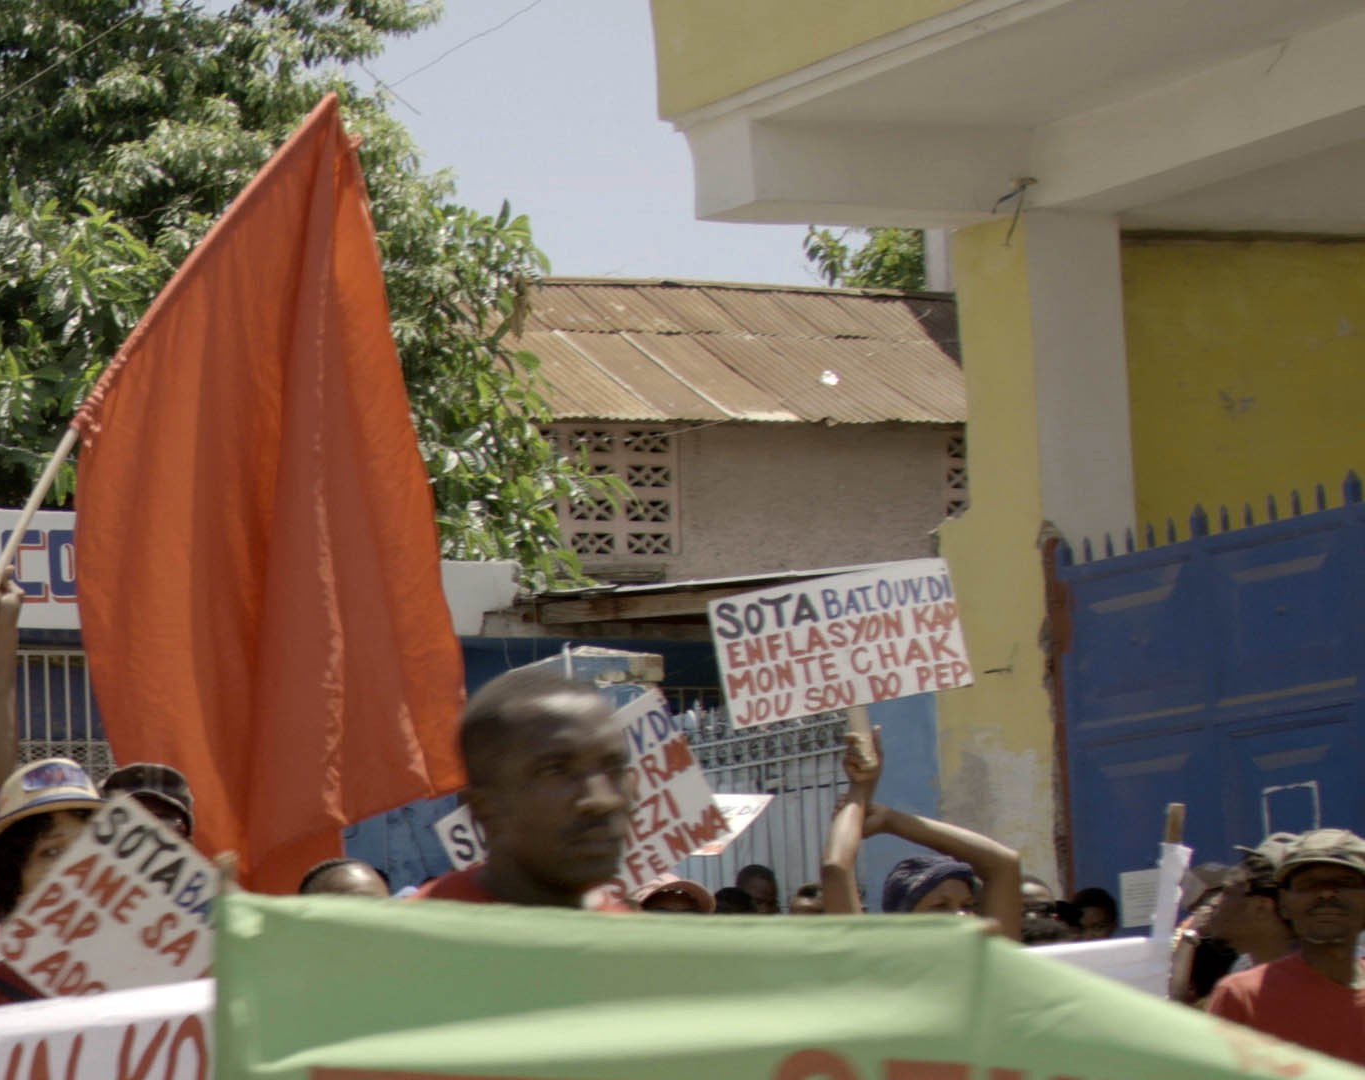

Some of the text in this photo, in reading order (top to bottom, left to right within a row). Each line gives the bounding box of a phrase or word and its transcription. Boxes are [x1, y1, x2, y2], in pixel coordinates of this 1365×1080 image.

[716, 592, 820, 640] SOTA
[725, 601, 959, 669] ENFLASYON KAP
[726, 632, 960, 700] MONTE CHAK
[735, 660, 970, 726] JOU SOU DO PEP
[93, 806, 187, 895] SOTA
[26, 881, 99, 945] PAP
[61, 853, 198, 967] AME SA
